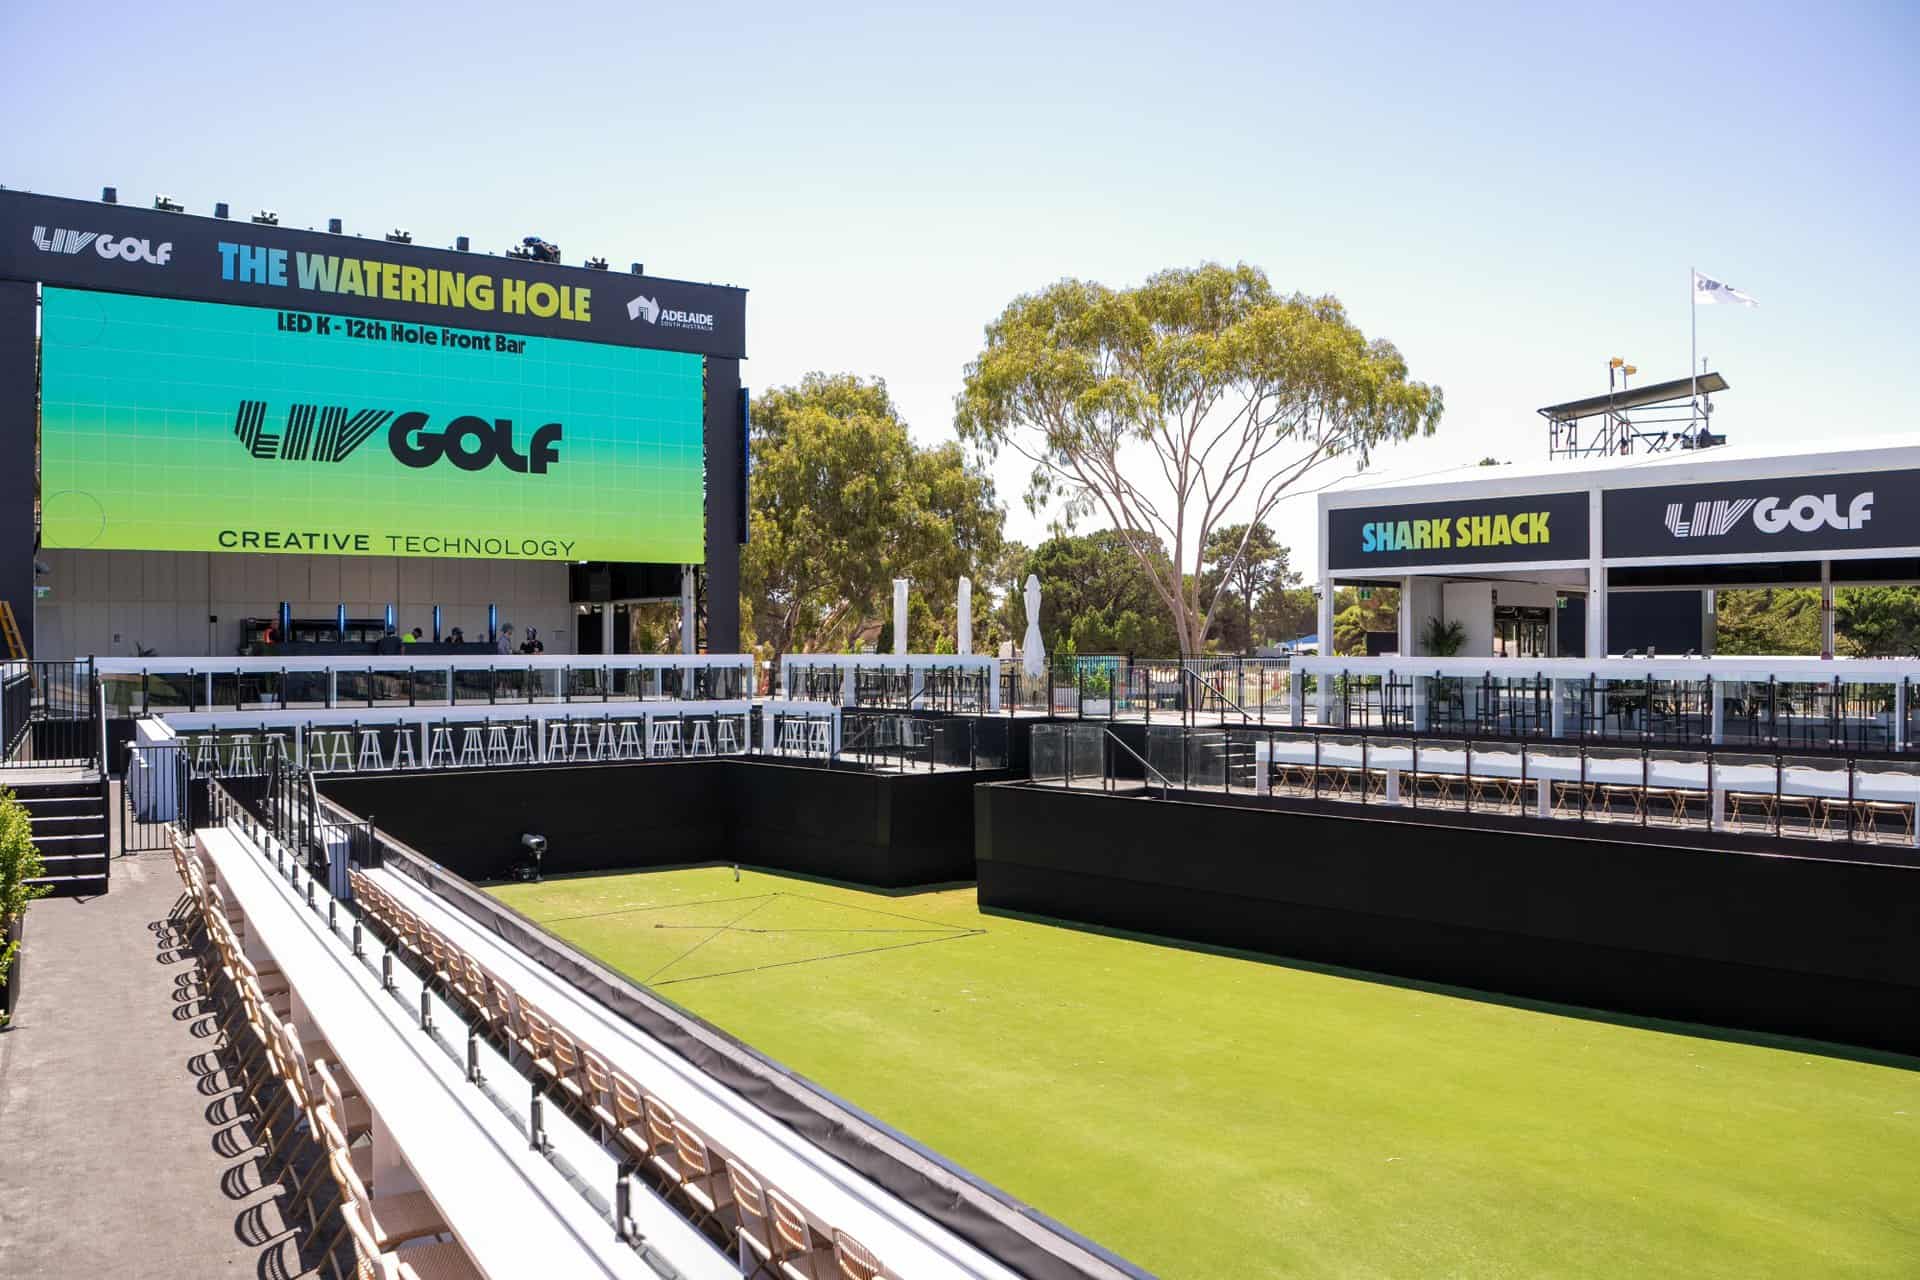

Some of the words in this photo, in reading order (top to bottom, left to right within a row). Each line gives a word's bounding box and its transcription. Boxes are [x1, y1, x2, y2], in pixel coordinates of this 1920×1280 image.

[218, 241, 288, 287] THE
[295, 252, 494, 312] WATERING
[502, 278, 592, 322] HOLE
[277, 312, 313, 334] LED
[316, 316, 331, 335] K
[345, 319, 388, 342] 12th
[391, 323, 438, 346] Hole
[442, 328, 491, 351] Front
[495, 333, 526, 354] Bar
[661, 309, 713, 326] ADELAIDE
[218, 530, 370, 551] CREATIVE
[386, 535, 576, 557] TECHNOLOGY
[1362, 518, 1452, 553] SHARK
[1455, 512, 1550, 548] SHACK
